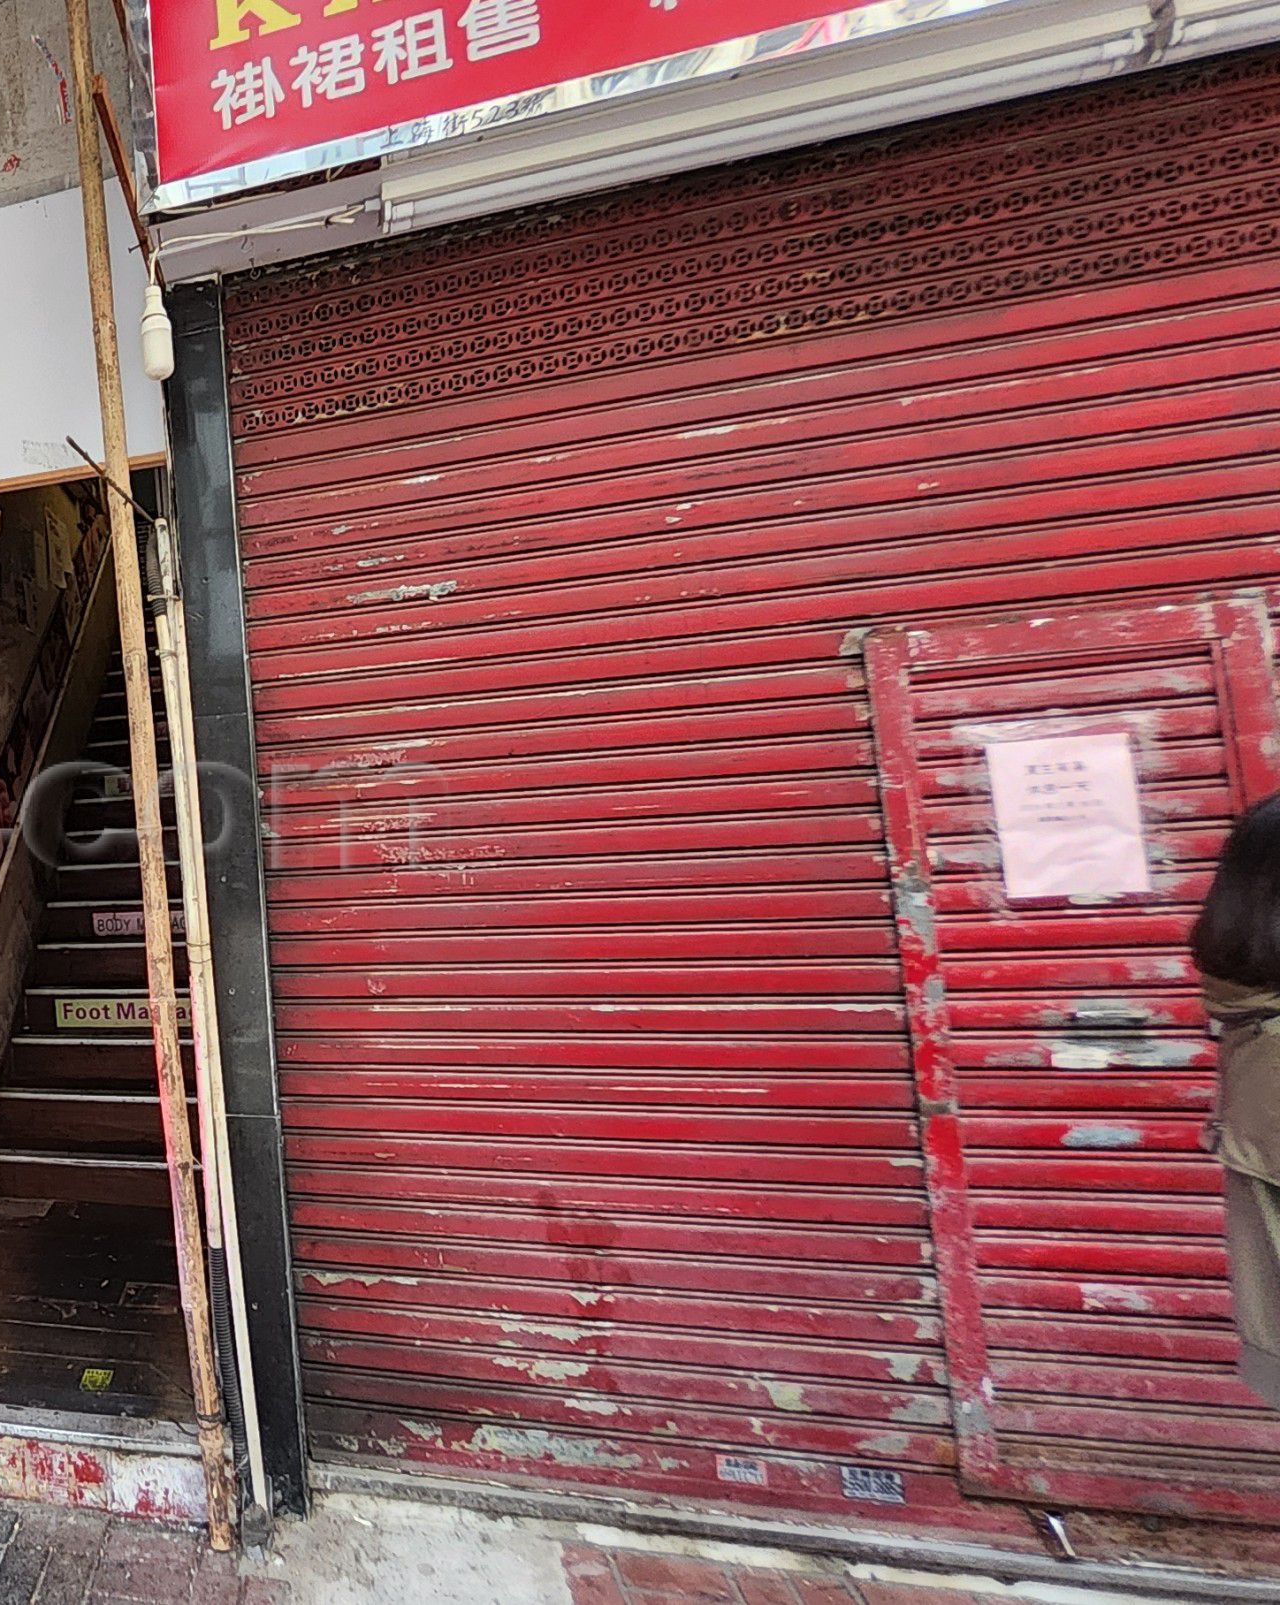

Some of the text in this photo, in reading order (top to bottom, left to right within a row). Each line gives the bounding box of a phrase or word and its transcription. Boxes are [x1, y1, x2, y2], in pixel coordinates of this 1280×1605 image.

[210, 0, 541, 130] 褂裙租售
[97, 918, 130, 933] BODY
[62, 1003, 110, 1020] Foot
